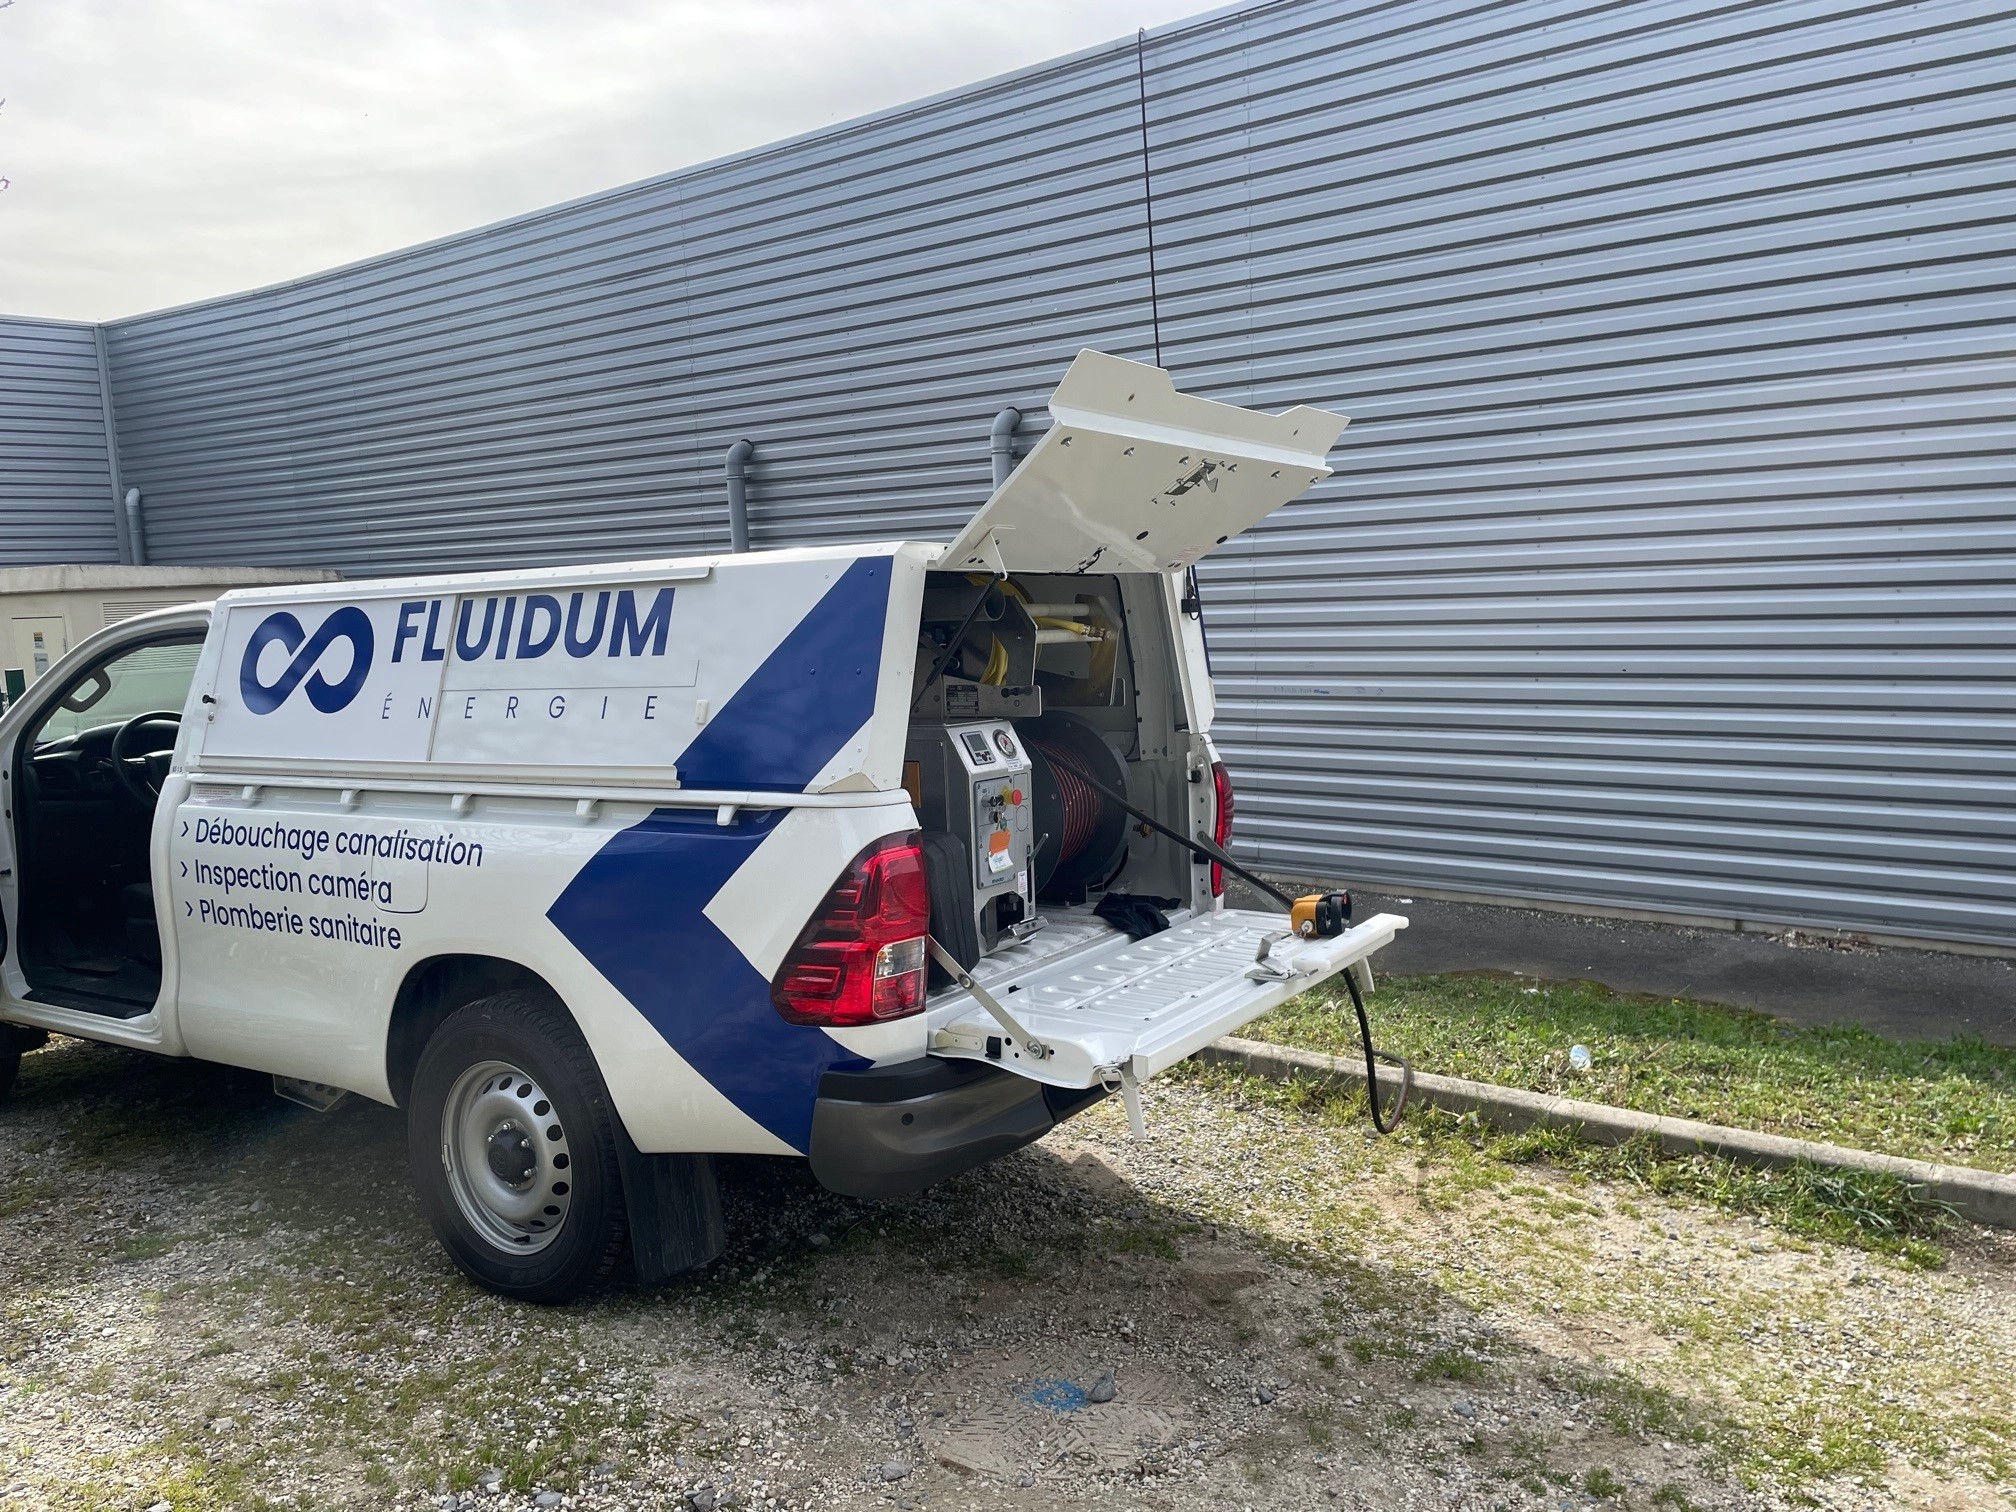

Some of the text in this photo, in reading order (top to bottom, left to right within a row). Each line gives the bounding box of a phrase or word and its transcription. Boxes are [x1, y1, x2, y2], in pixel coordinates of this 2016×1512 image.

[391, 587, 676, 663] FLUIDUM
[381, 692, 658, 720] ÉNERGIE
[195, 817, 483, 867] Débouchage canalisation
[195, 858, 392, 904] Inspection caméra
[199, 899, 402, 950] Plomberie sanitaire
